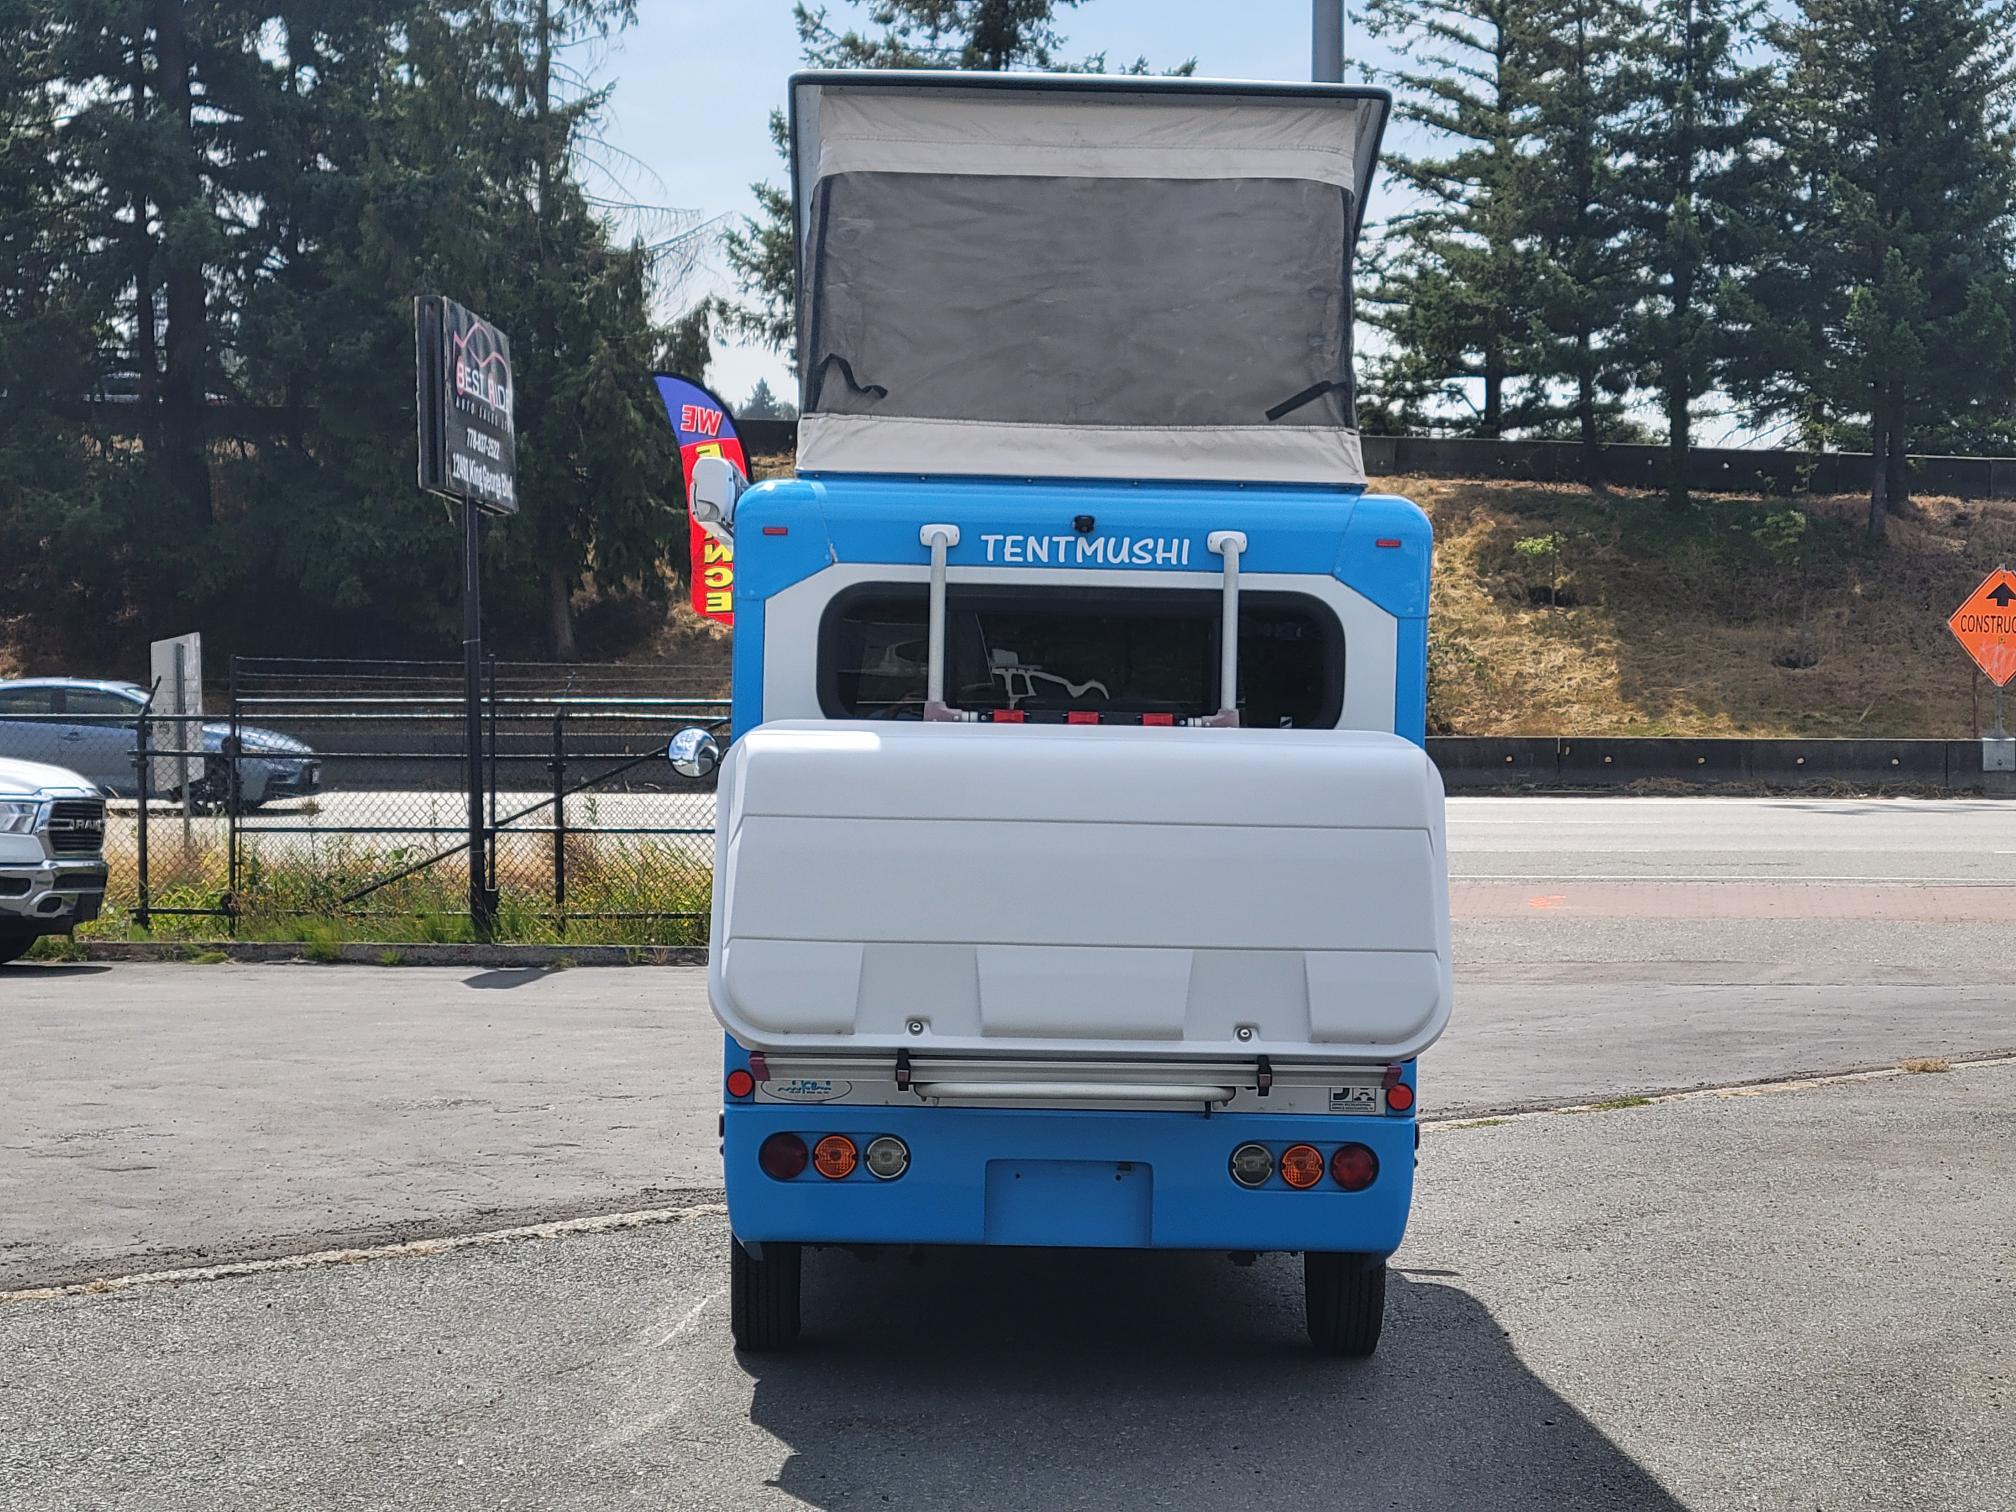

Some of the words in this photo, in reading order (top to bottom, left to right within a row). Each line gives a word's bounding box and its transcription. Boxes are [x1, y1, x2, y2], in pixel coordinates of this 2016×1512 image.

[456, 361, 485, 398] BEST
[456, 396, 475, 415] AUTO
[469, 458, 483, 494] King
[482, 464, 501, 500] George
[980, 534, 1191, 566] TENTMUSHI
